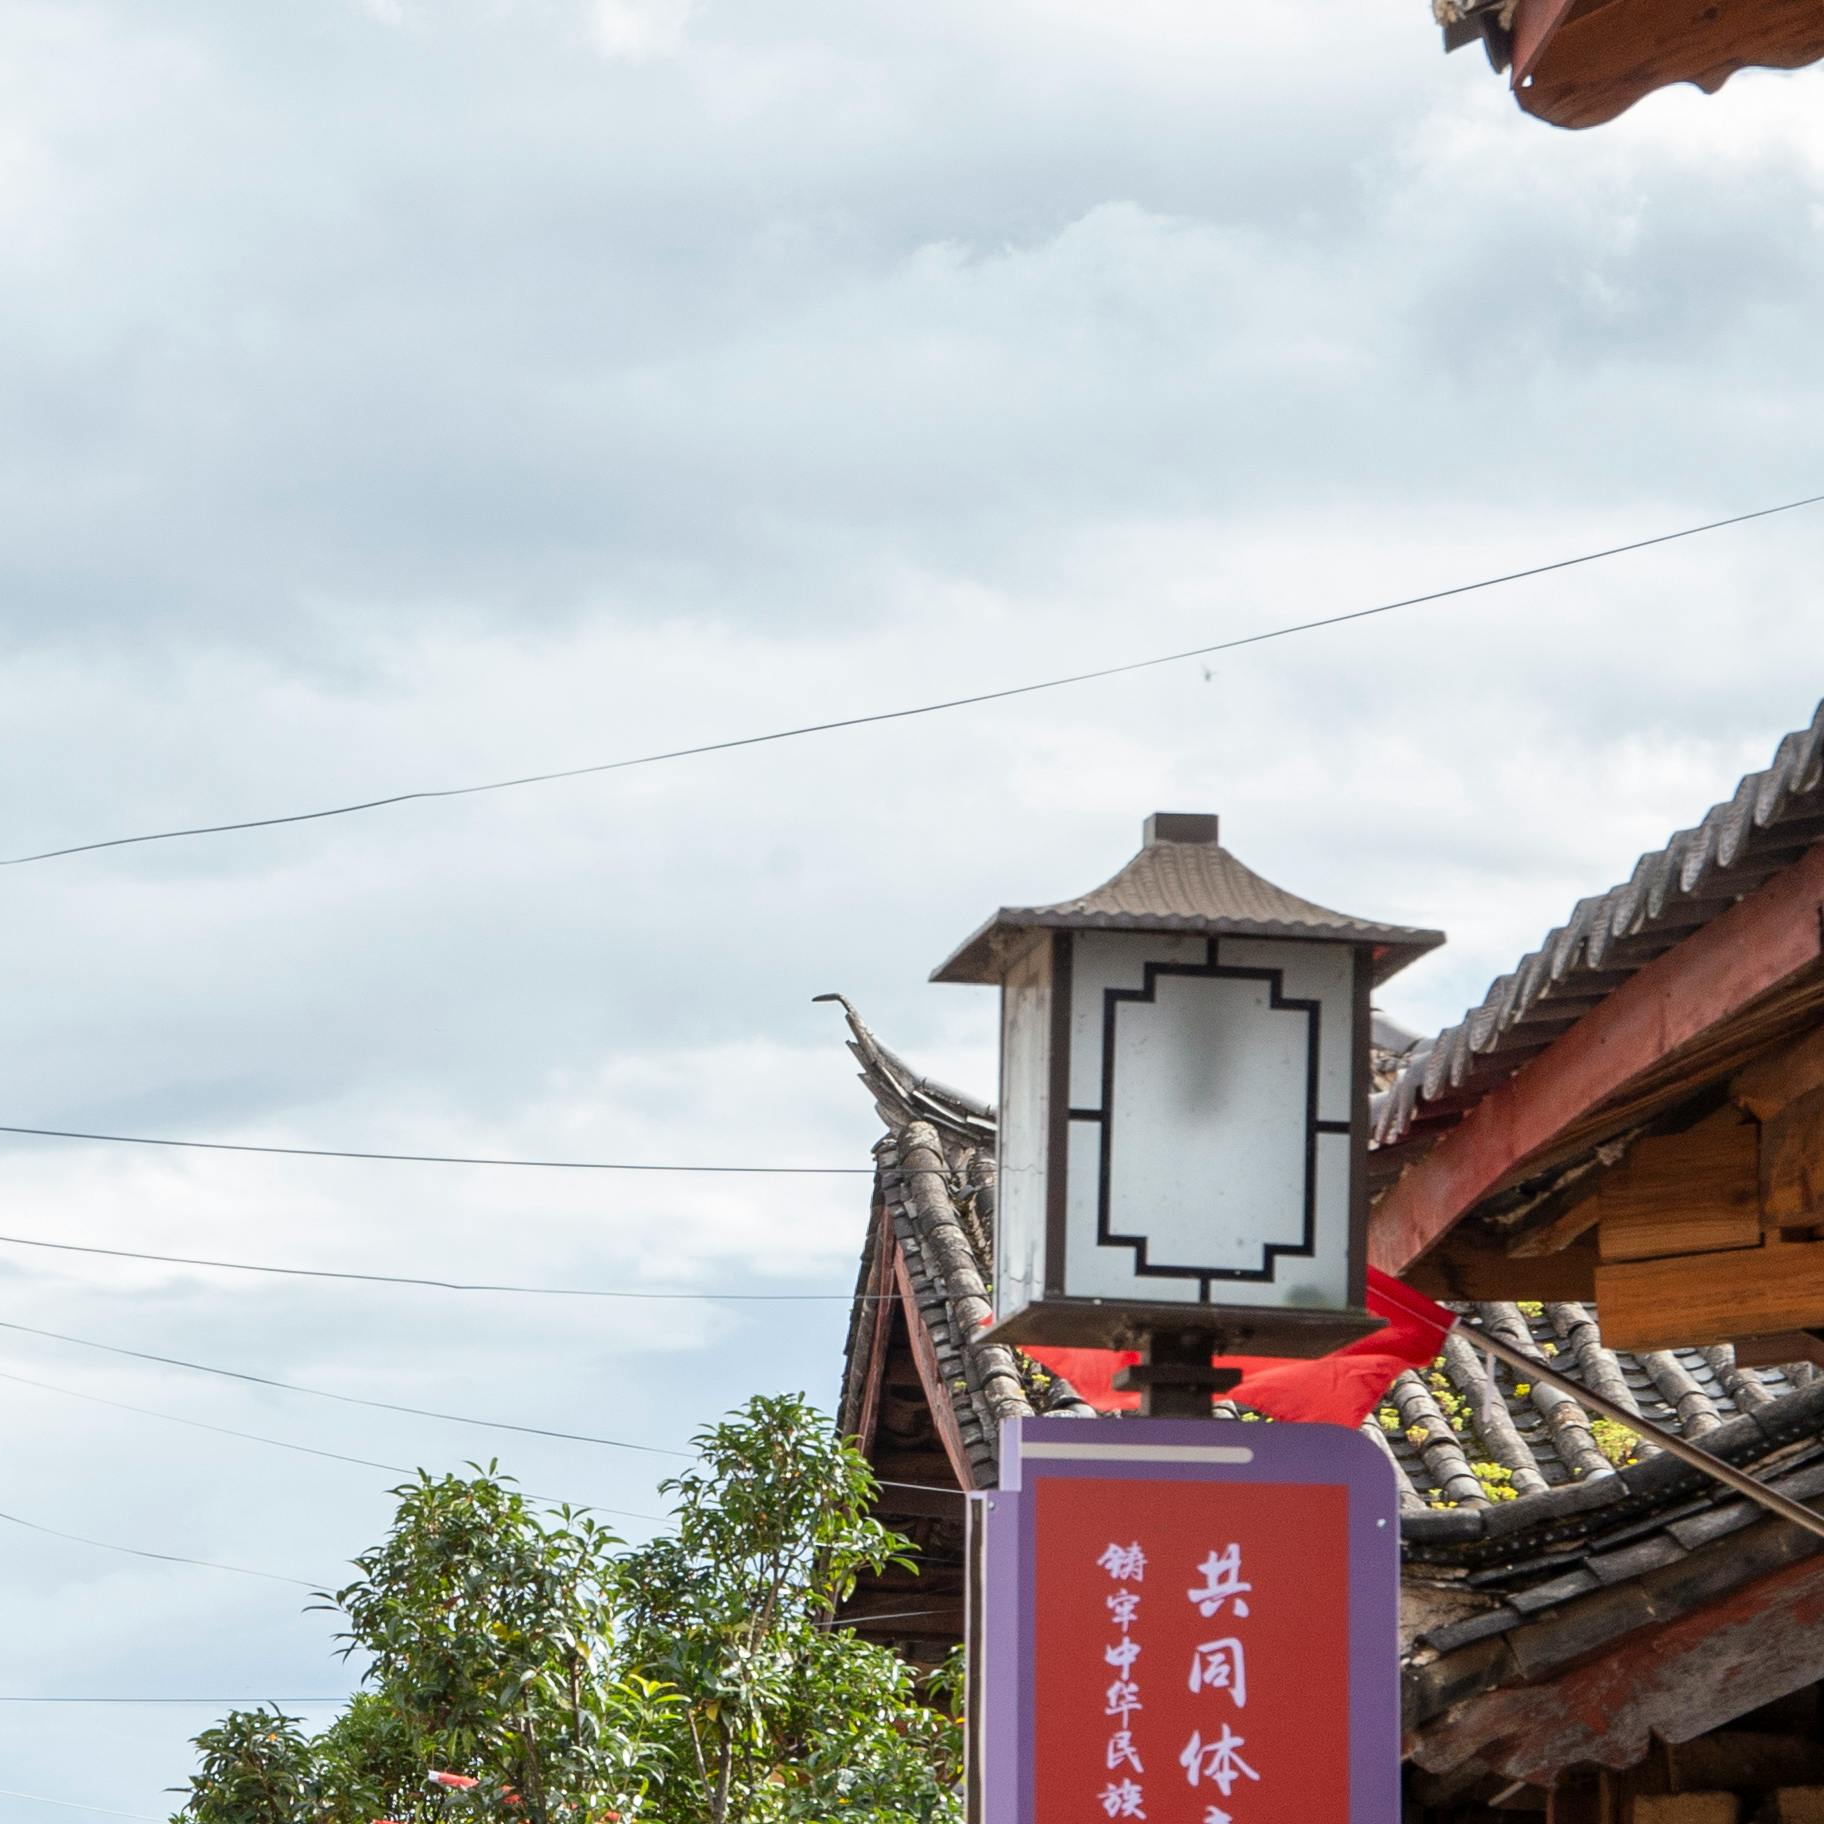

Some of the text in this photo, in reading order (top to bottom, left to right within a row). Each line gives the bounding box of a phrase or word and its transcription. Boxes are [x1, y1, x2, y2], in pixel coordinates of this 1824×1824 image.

[1096, 1541, 1149, 1822] 铸牢中华民族
